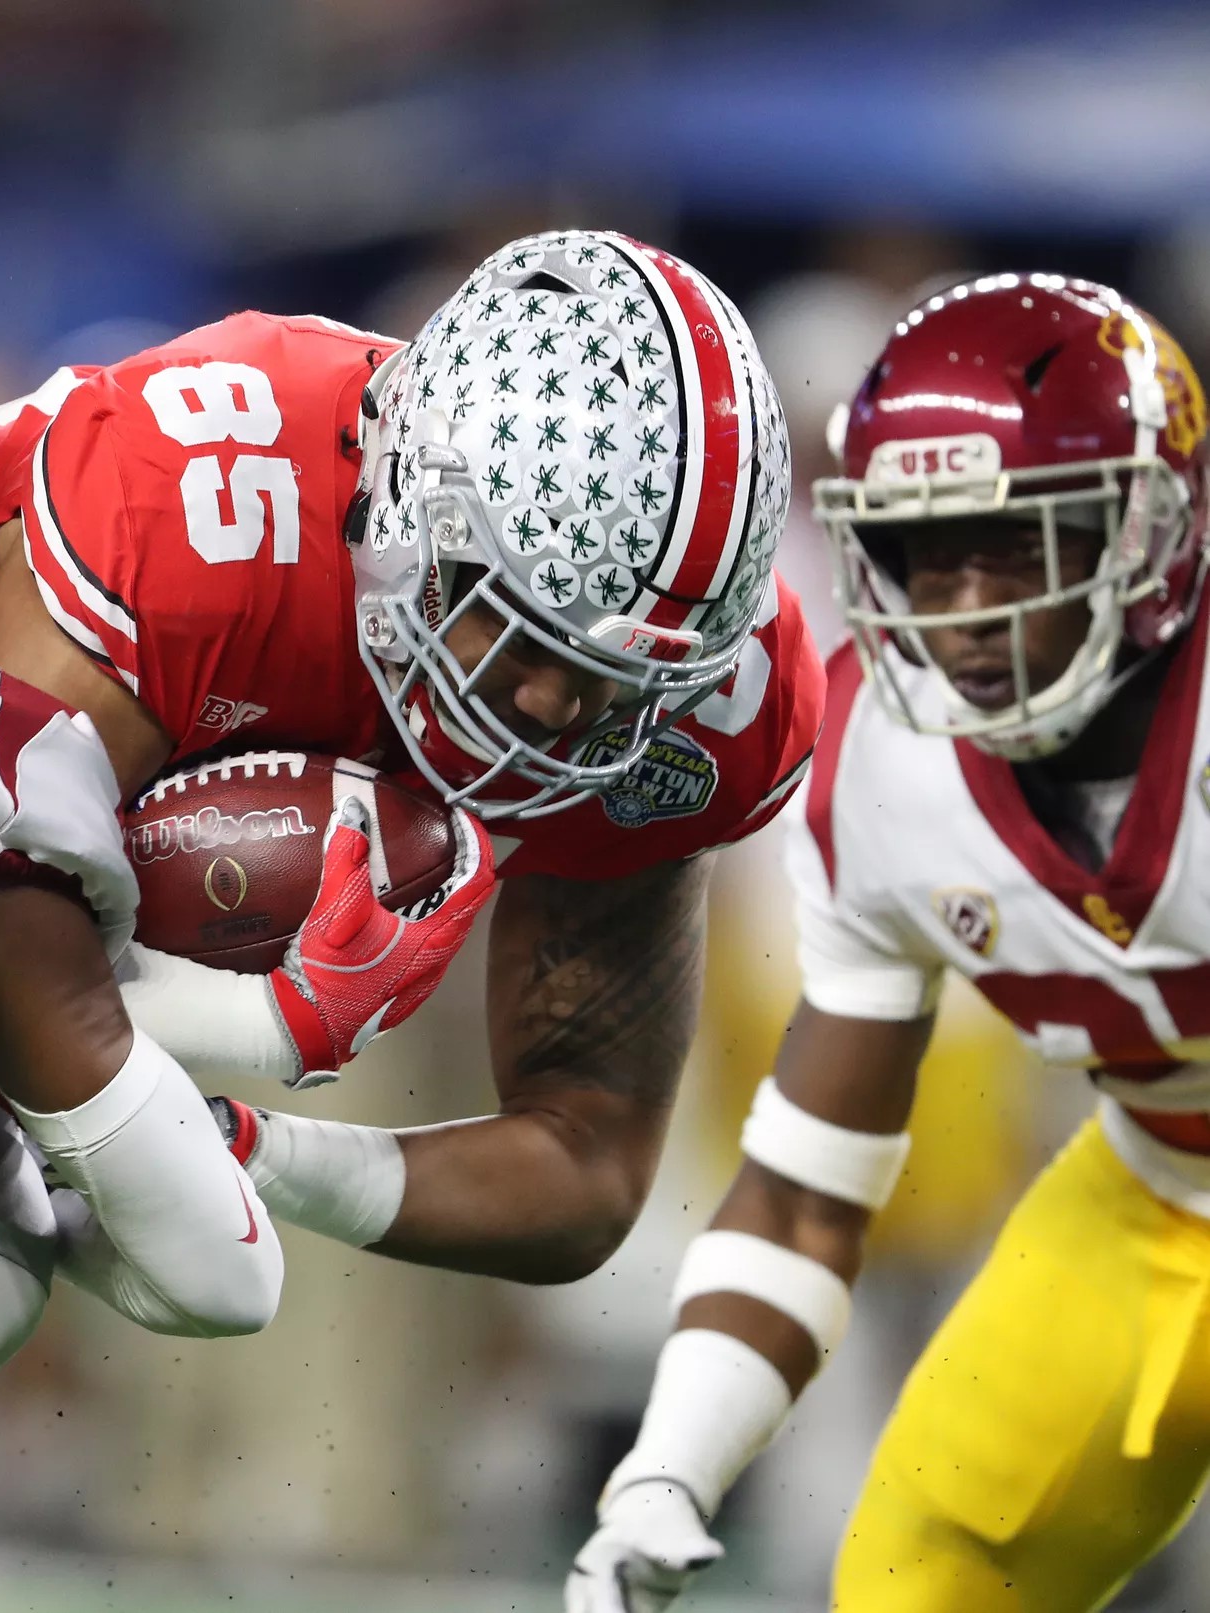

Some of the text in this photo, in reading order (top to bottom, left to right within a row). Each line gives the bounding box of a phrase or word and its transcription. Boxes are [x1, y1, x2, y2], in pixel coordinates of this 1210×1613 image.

[142, 361, 300, 565] 85
[899, 447, 967, 475] USC
[612, 773, 675, 806] OWL
[130, 806, 310, 865] Wilson
